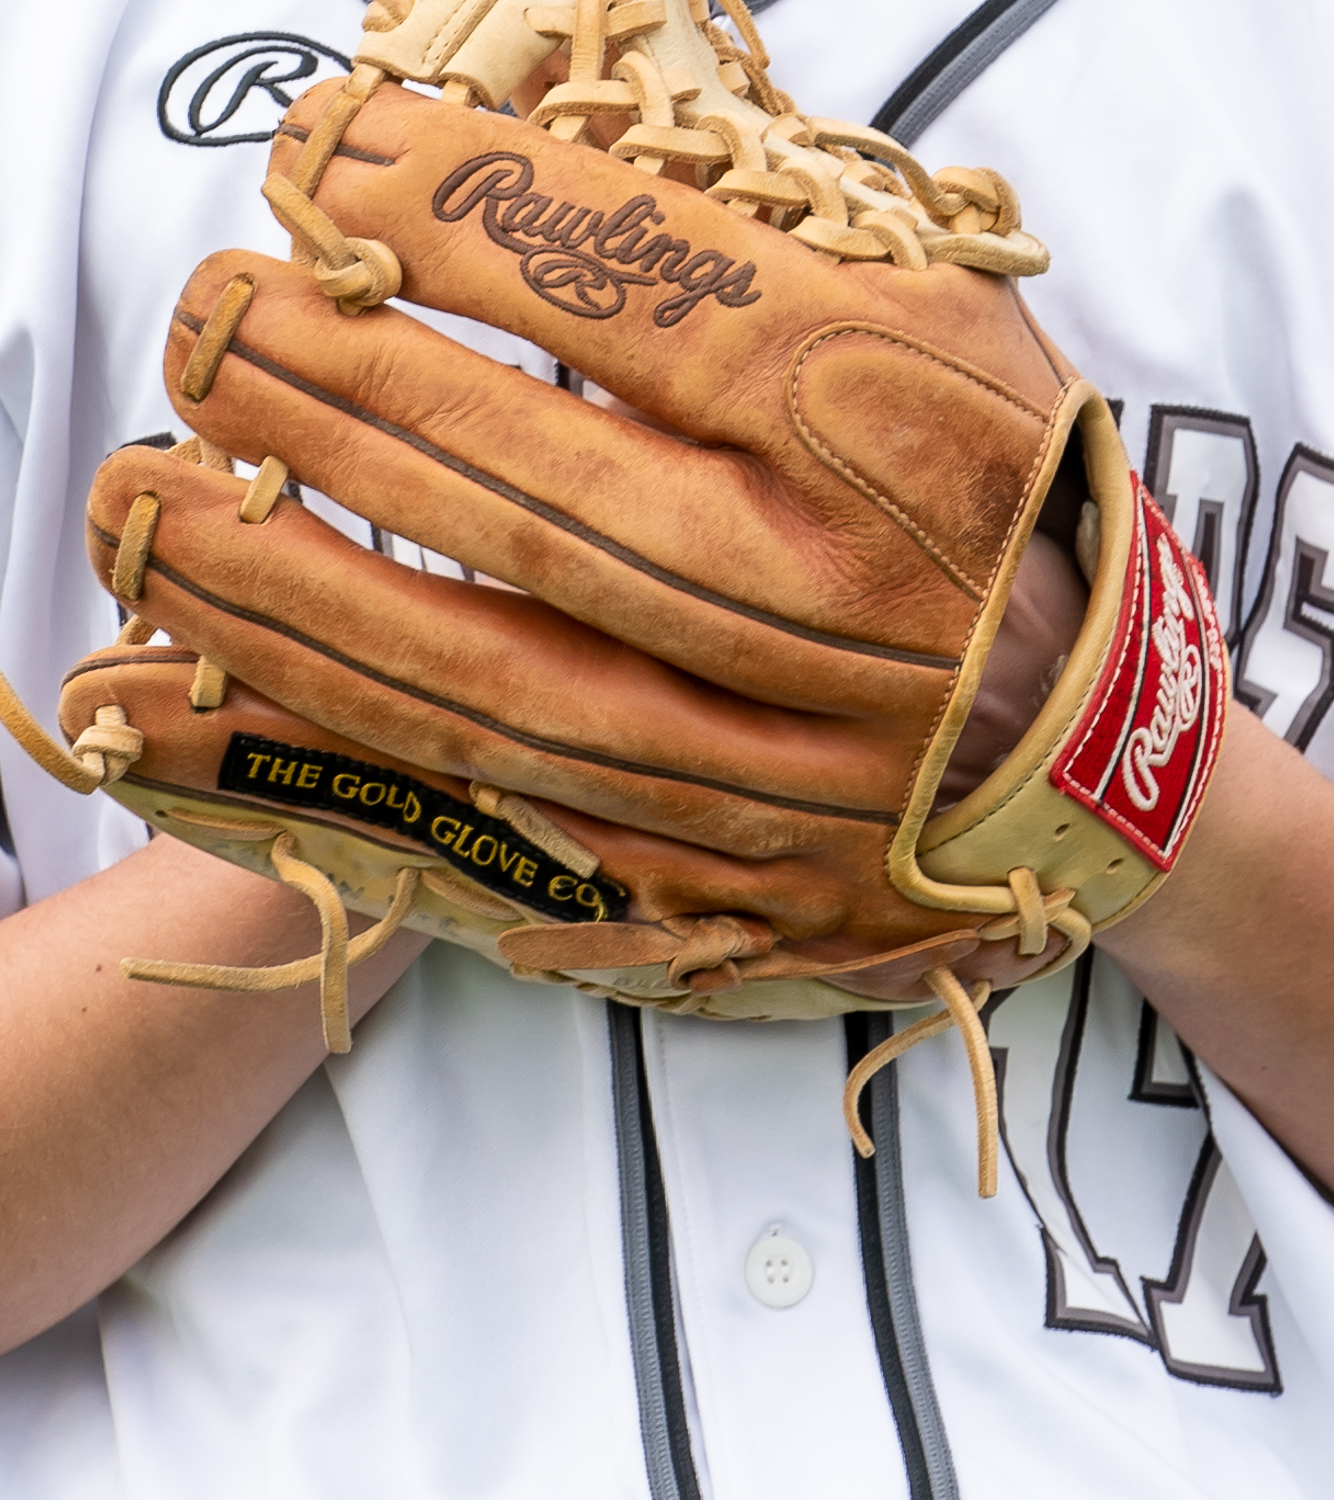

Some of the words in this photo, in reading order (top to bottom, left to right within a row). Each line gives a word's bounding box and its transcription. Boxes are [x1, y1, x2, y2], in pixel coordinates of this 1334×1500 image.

[431, 150, 762, 328] Rawlings
[246, 752, 324, 789] THE
[332, 773, 422, 824] GOLD
[431, 815, 539, 888] GLOVE
